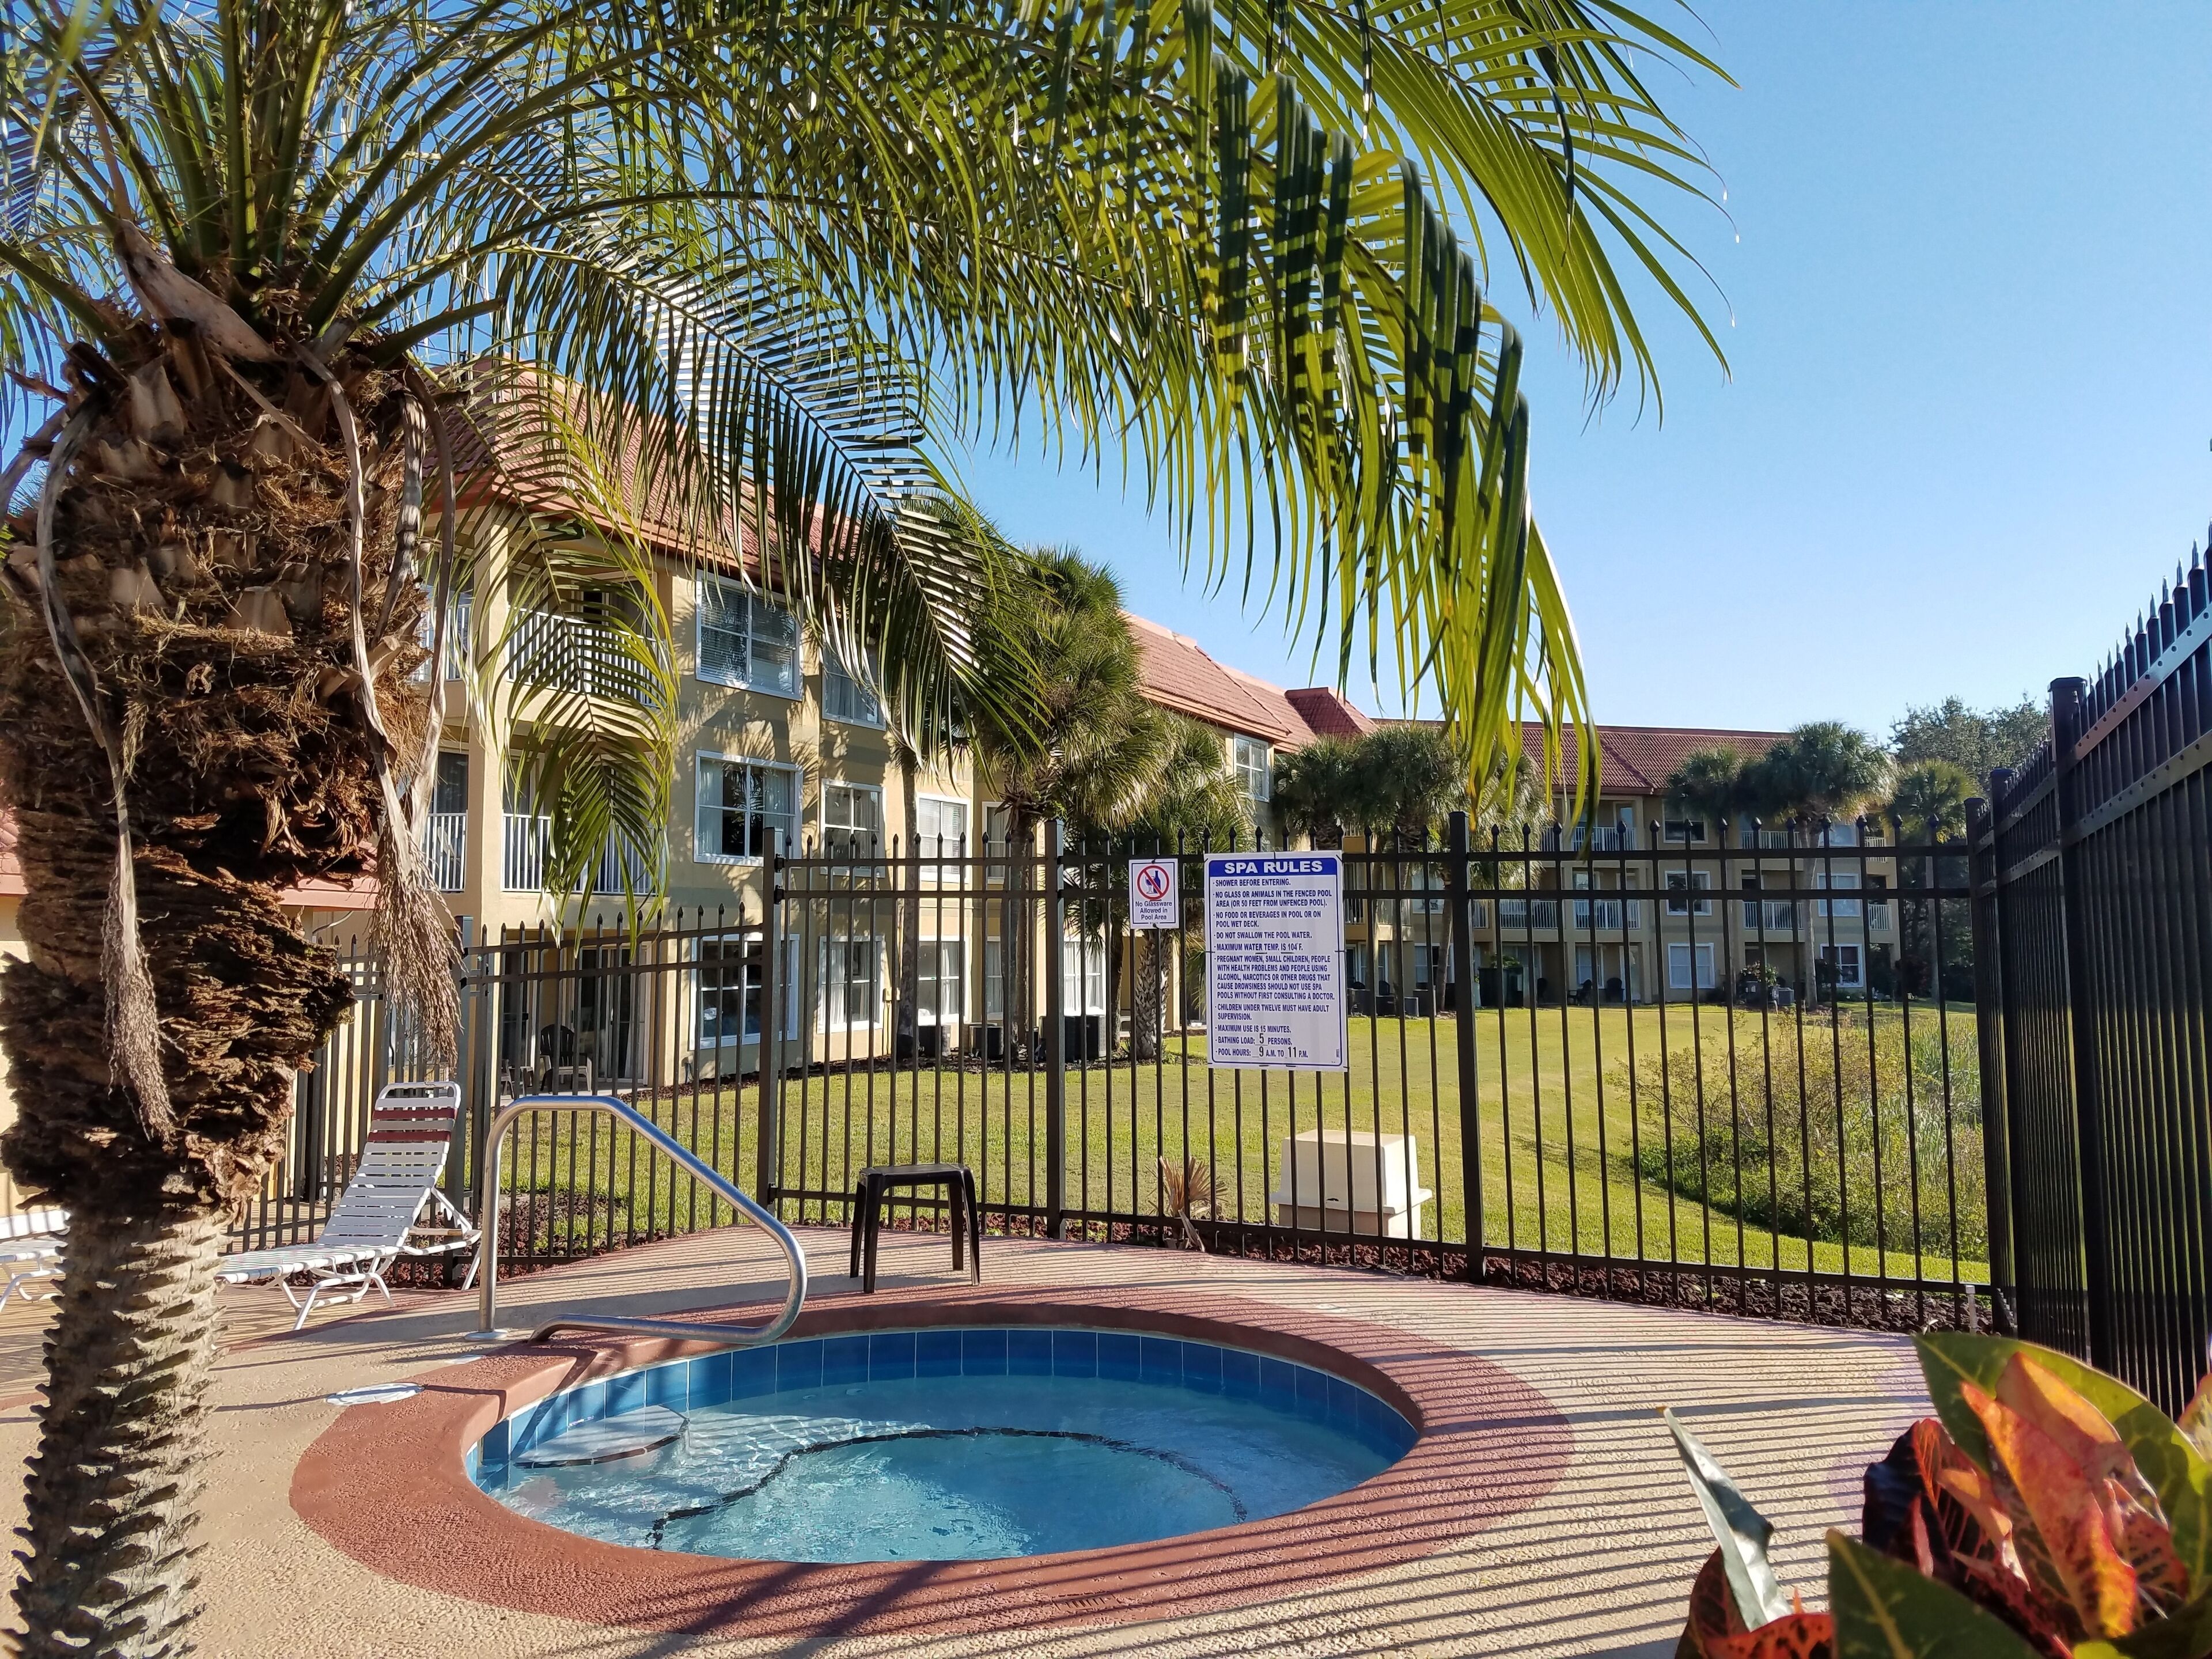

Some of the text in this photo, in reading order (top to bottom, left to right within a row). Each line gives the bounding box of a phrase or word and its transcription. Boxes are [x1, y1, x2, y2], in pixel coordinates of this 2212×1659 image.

[1224, 861, 1323, 874] SPA RULES
[1230, 900, 1240, 909] (OR
[1309, 899, 1327, 908] POOL).
[1244, 956, 1264, 964] WOMEN,
[1217, 974, 1241, 982] ALCOHOL,
[1267, 1025, 1291, 1033] MINUTES.
[1259, 1033, 1264, 1044] 5
[1267, 1037, 1292, 1046] PERSONS.
[1259, 1046, 1264, 1057] 9
[1287, 1047, 1297, 1058] 11
